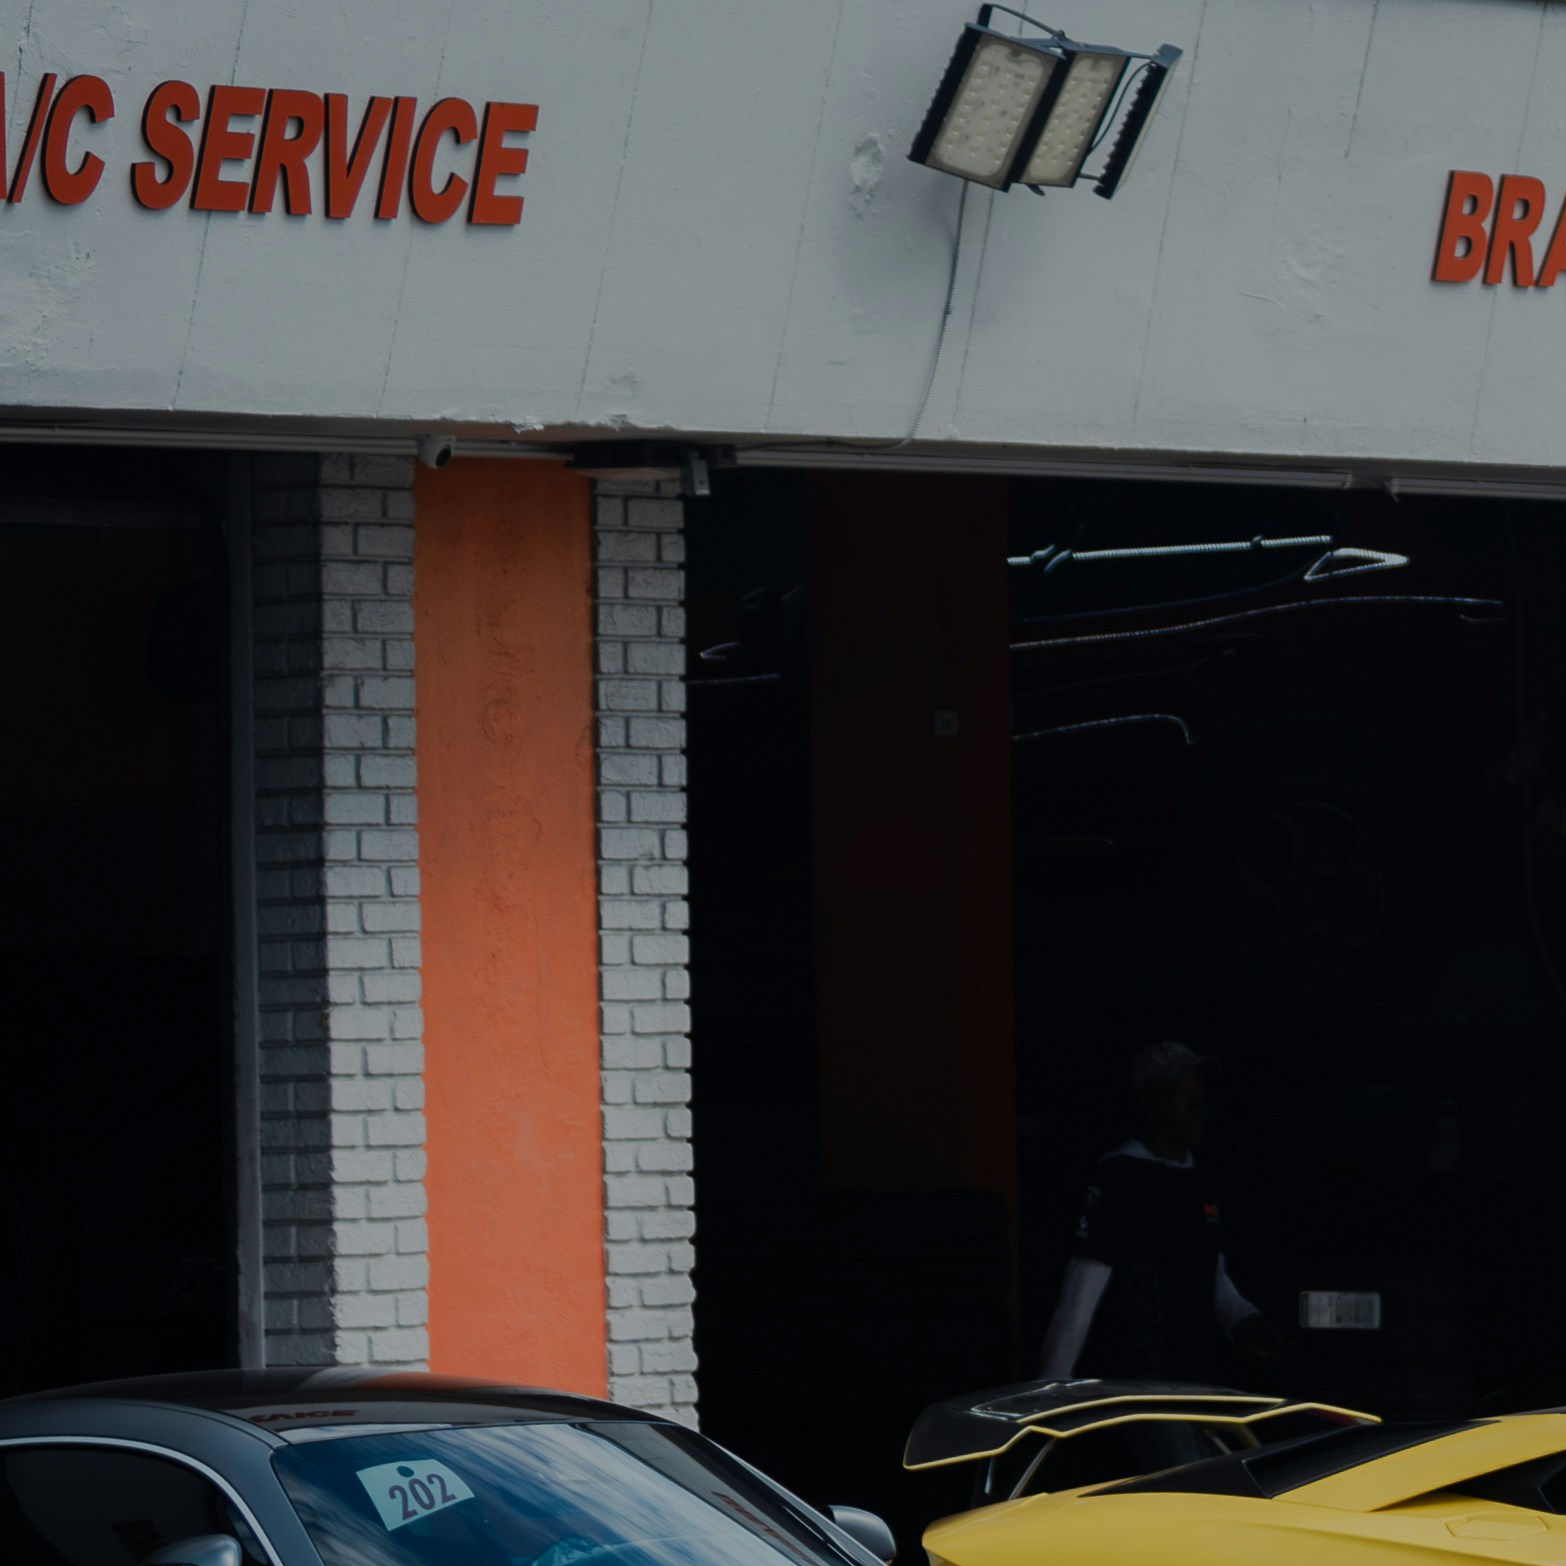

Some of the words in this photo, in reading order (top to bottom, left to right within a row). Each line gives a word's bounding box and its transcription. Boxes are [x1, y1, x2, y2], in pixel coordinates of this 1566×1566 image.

[0, 71, 115, 206] /C
[131, 79, 539, 226] SERVICE
[388, 1473, 457, 1520] 202
